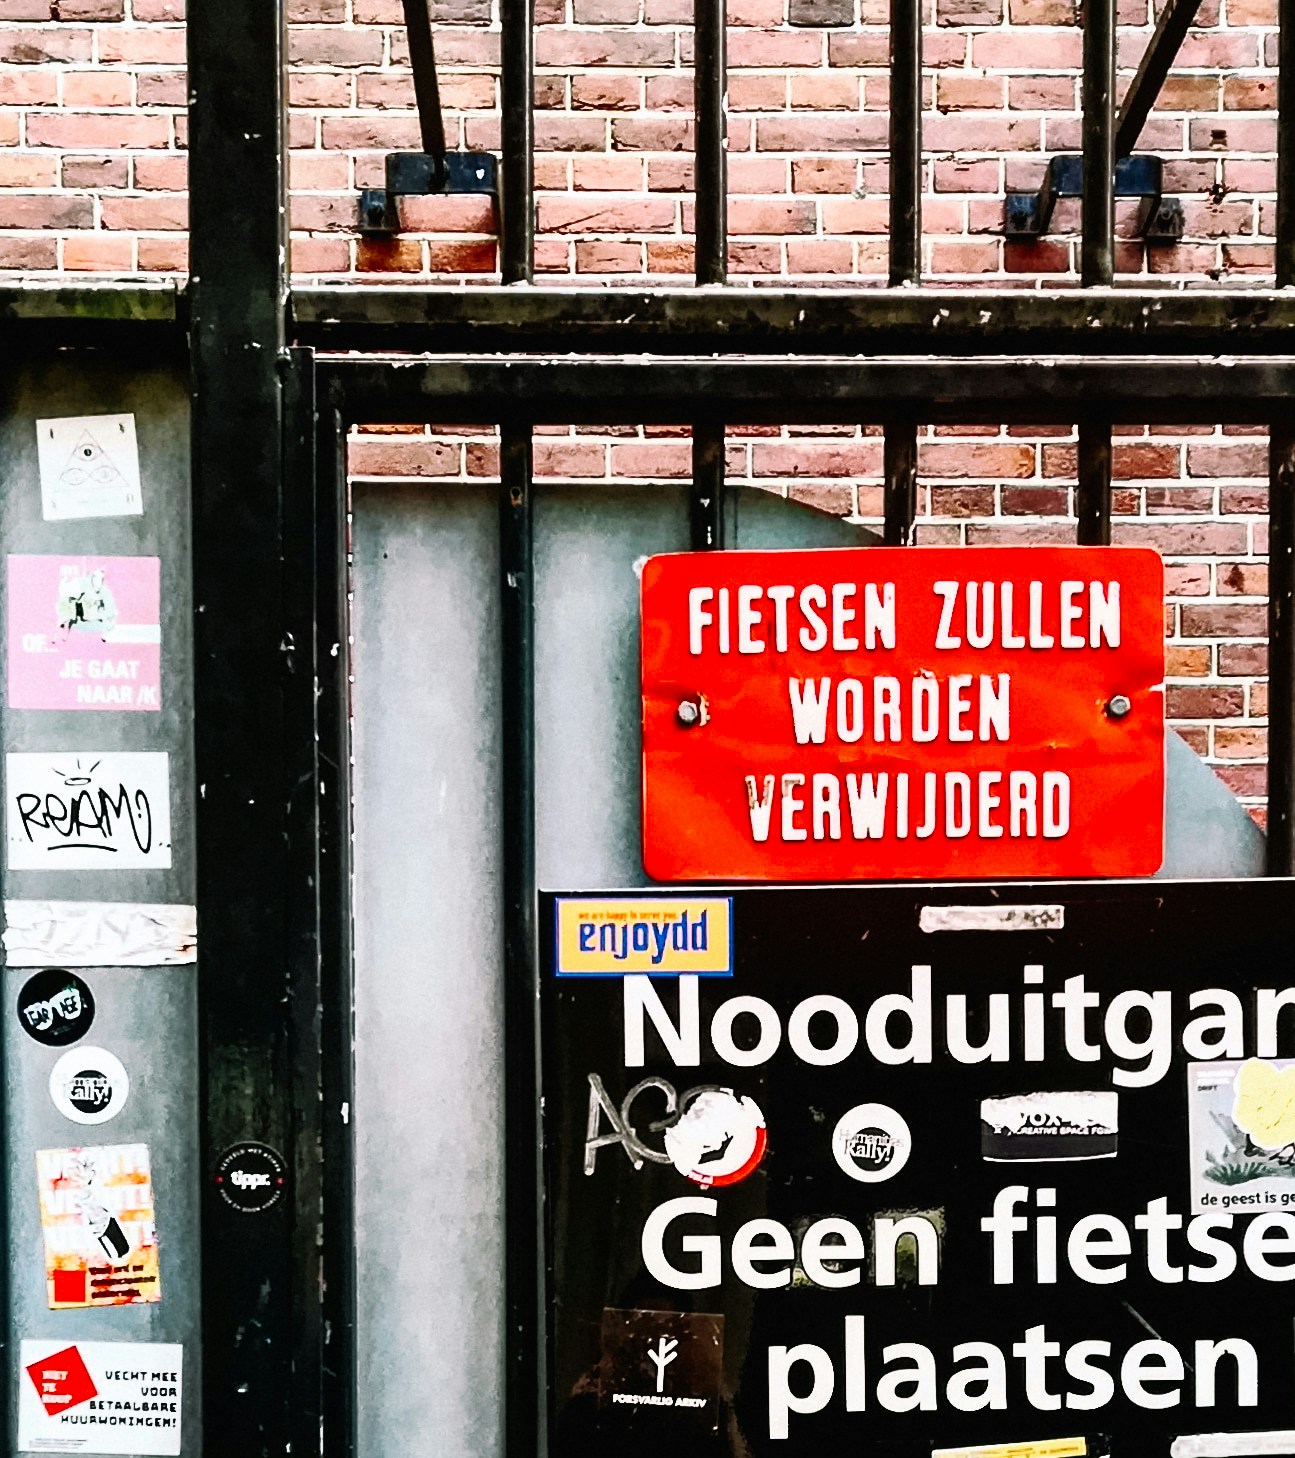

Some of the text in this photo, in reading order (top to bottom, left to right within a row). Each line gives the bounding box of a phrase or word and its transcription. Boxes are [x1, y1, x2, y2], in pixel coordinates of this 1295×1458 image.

[688, 581, 1123, 655] FIETSEN ZULLEN
[59, 660, 140, 679] JE GAAT
[77, 685, 132, 703] NAAR
[788, 674, 1012, 745] WORDEN
[745, 771, 1071, 842] VERWIJDERD
[580, 908, 708, 964] enjoydd
[844, 1139, 892, 1164] Rally!
[1201, 1193, 1218, 1205] de
[1222, 1192, 1262, 1208] geest
[1265, 1191, 1277, 1203] is
[641, 1196, 940, 1289] Geen
[105, 1371, 178, 1382] VECHT MEE
[768, 1315, 1259, 1439] plaatsen
[141, 1387, 178, 1397] VOOR
[89, 1401, 177, 1413] BETAALBARE
[61, 1415, 177, 1428] HUURWONINGEN!
